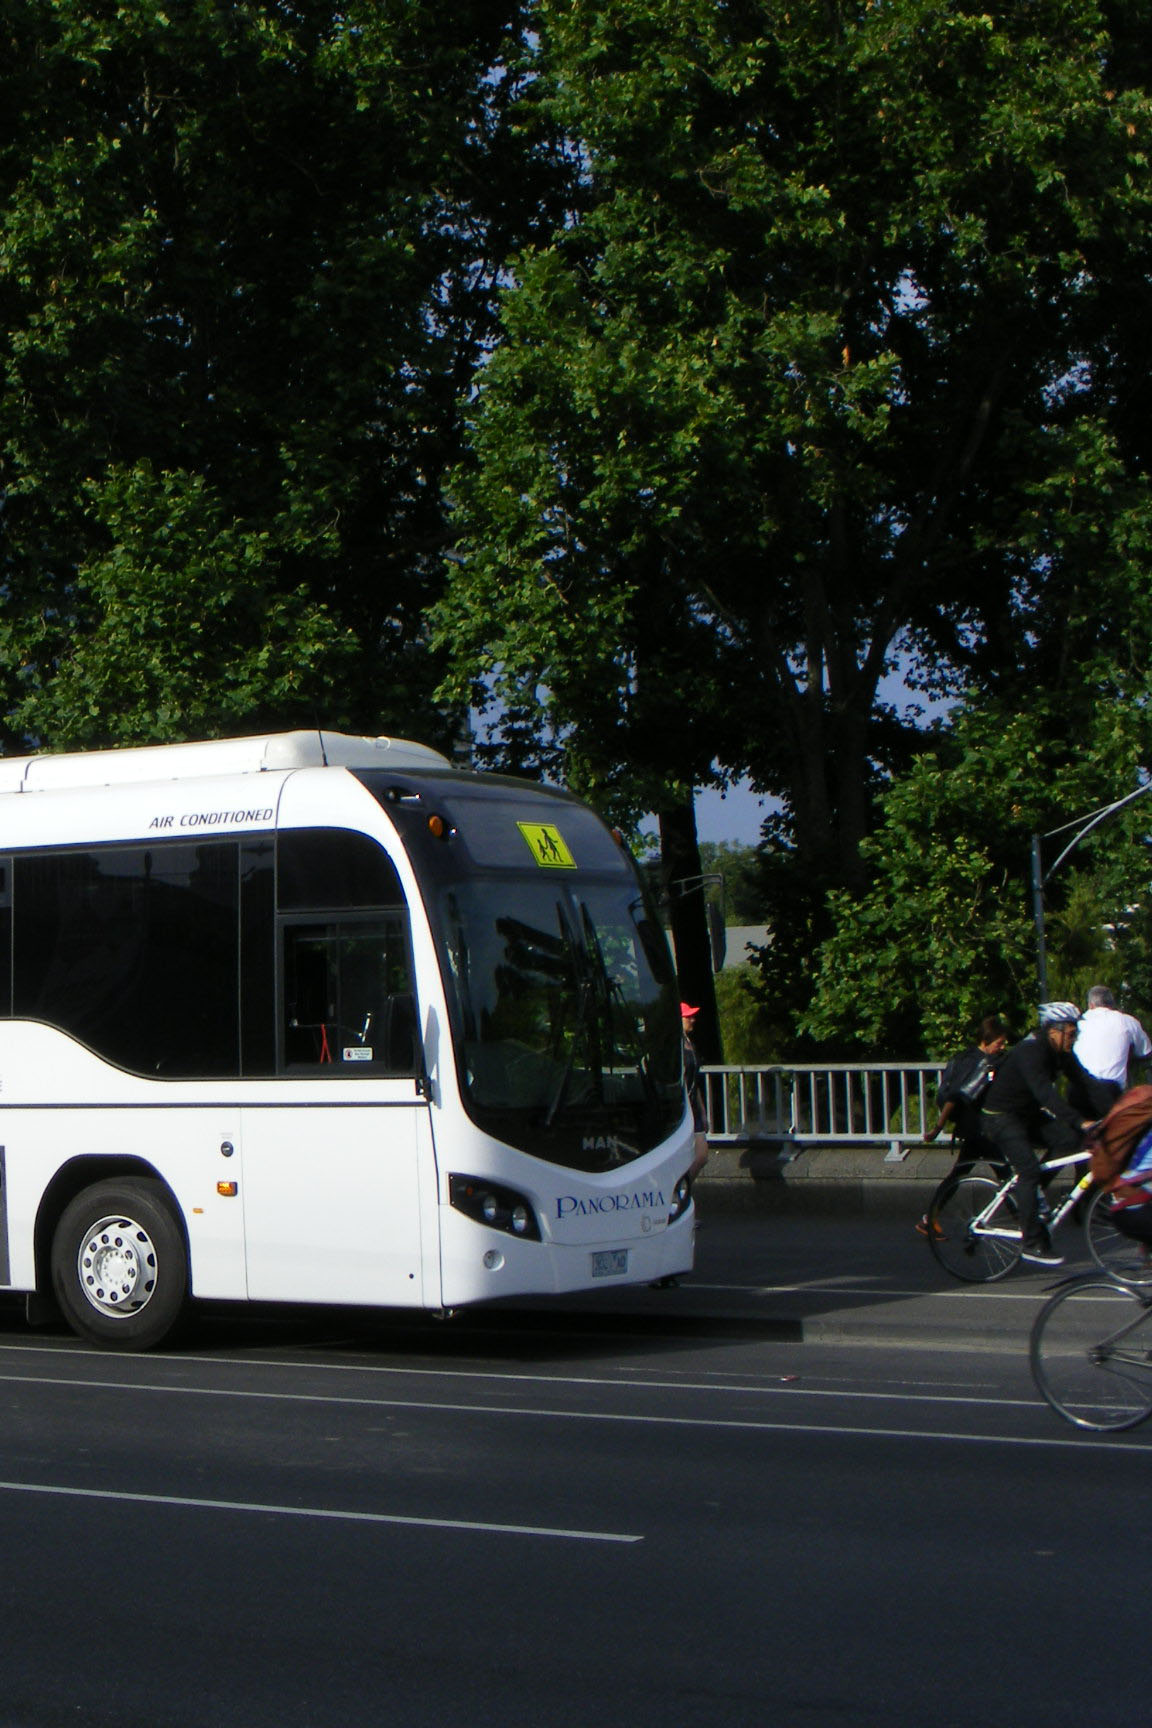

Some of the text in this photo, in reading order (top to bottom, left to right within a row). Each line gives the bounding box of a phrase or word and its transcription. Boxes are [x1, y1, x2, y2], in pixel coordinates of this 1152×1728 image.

[149, 808, 274, 829] AIR CONDITIONED
[582, 1135, 618, 1150] MAN
[555, 1191, 666, 1219] PANORAMA
